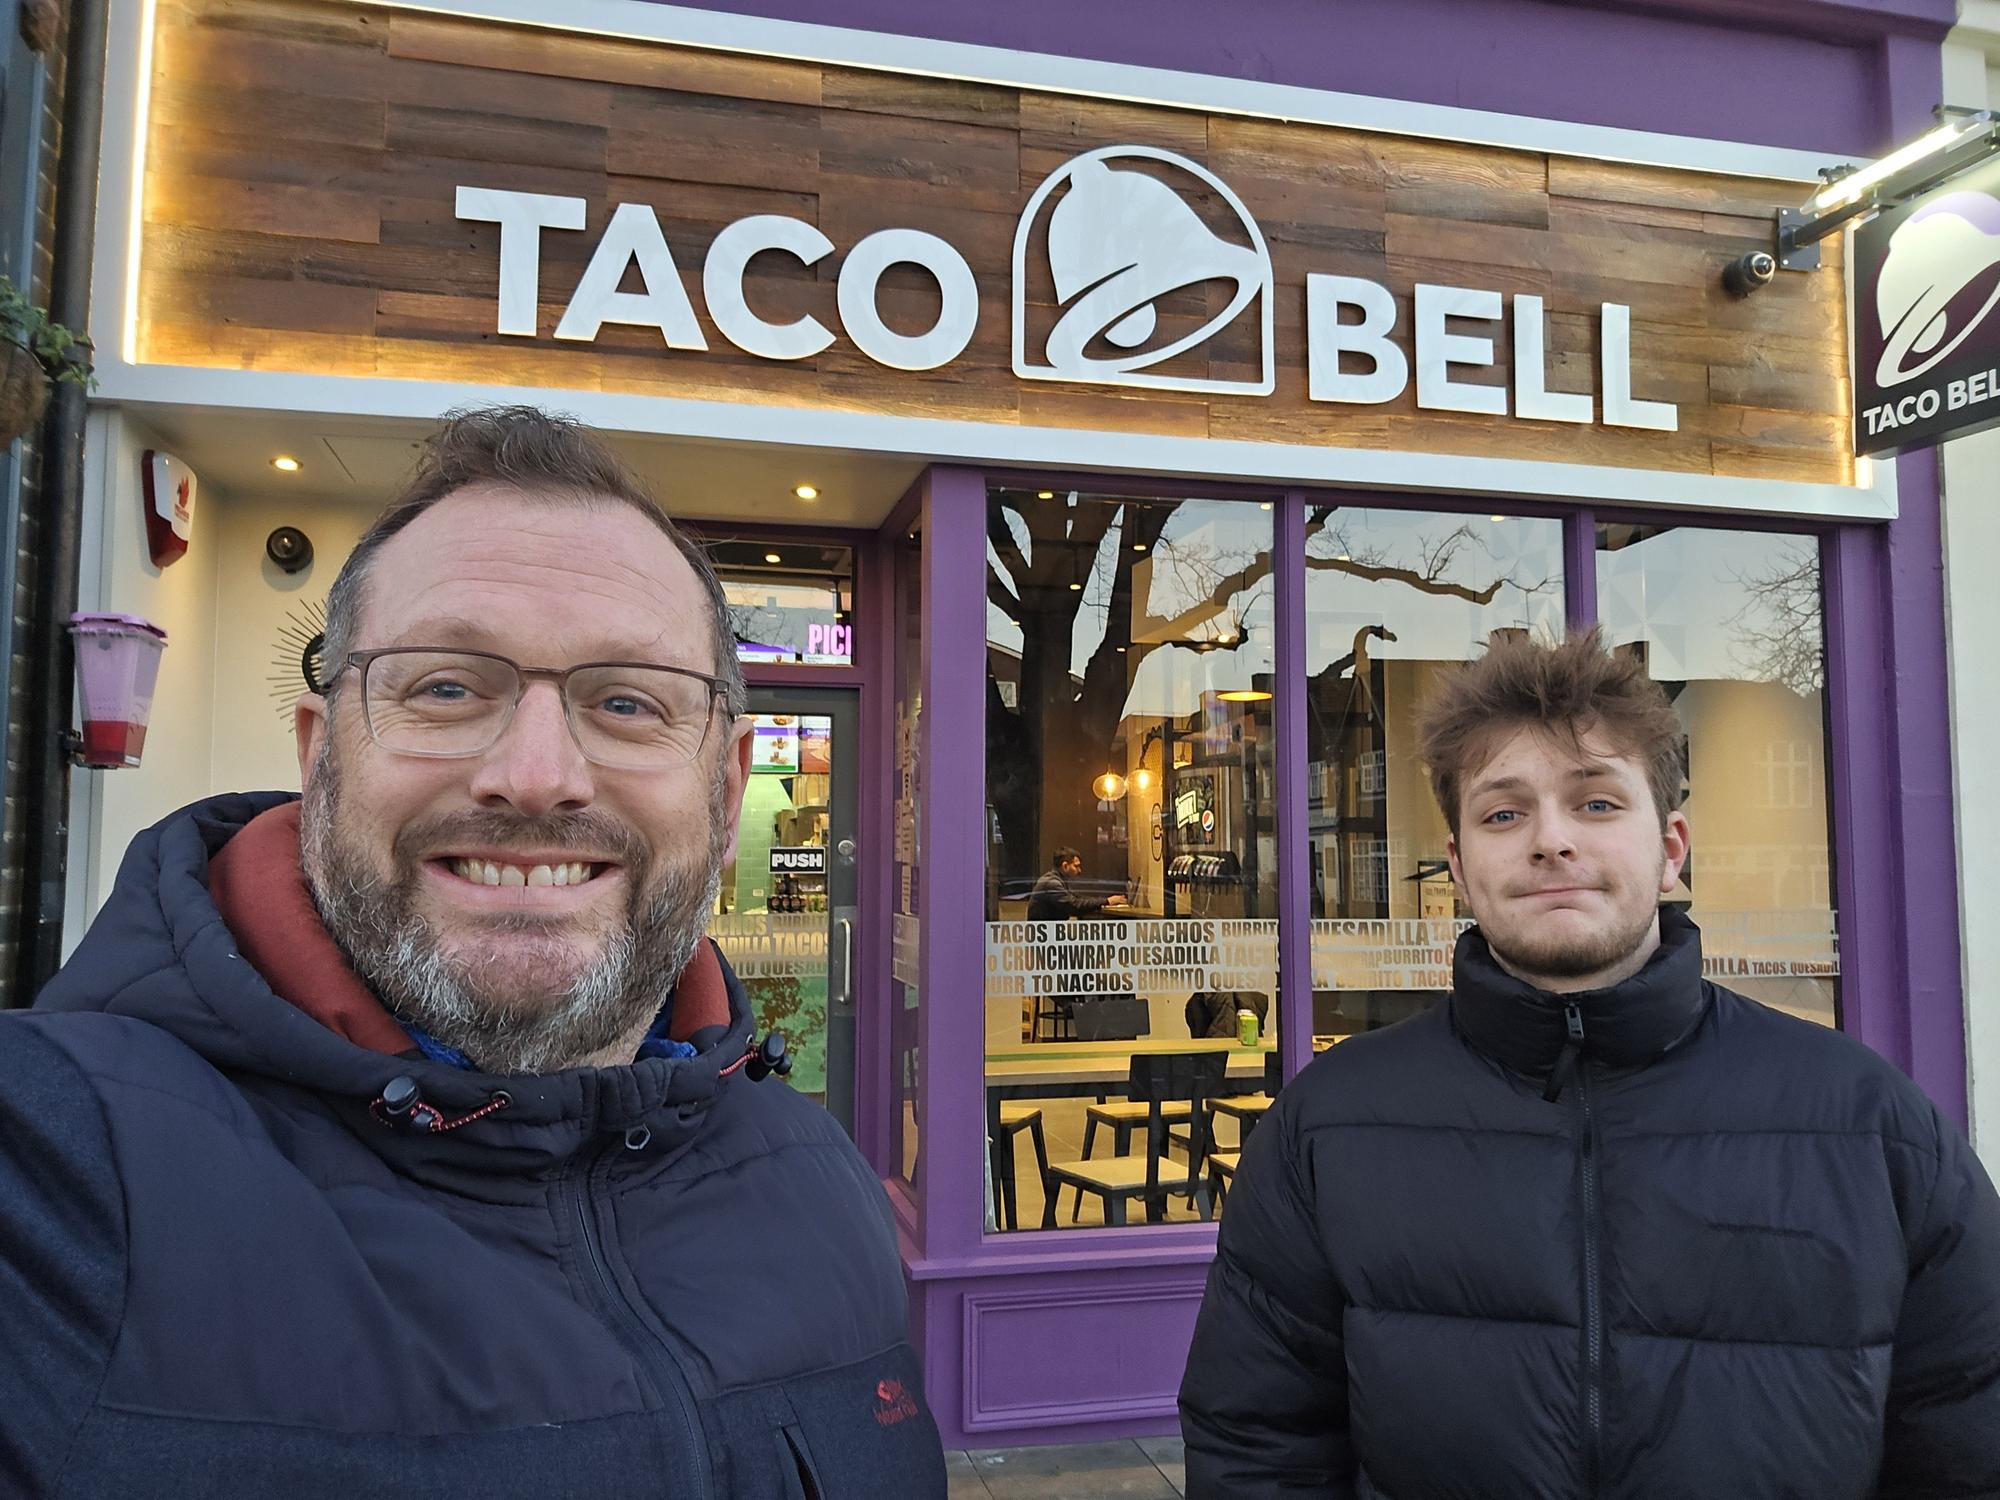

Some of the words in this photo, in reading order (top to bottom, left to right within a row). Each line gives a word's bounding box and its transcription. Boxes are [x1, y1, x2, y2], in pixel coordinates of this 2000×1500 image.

[455, 185, 979, 372] TACO
[1306, 272, 1679, 433] BELL
[1862, 389, 1940, 436] TACO
[1947, 368, 2000, 411] BEL
[771, 853, 823, 868] PUSH
[990, 923, 1048, 944] TACOS
[1055, 922, 1127, 941] BURRITO
[1136, 921, 1215, 944] NACHOS
[1222, 921, 1277, 937] BURRIT
[1311, 921, 1429, 945] UESADILLA
[1002, 945, 1116, 971] CRUNCHWRAP
[1118, 946, 1220, 967] QUESADILLA
[1383, 949, 1443, 965] BURRITO
[1752, 962, 1786, 975] TACOS
[1057, 972, 1133, 993] NACHOS
[1138, 968, 1204, 990] BURRITO
